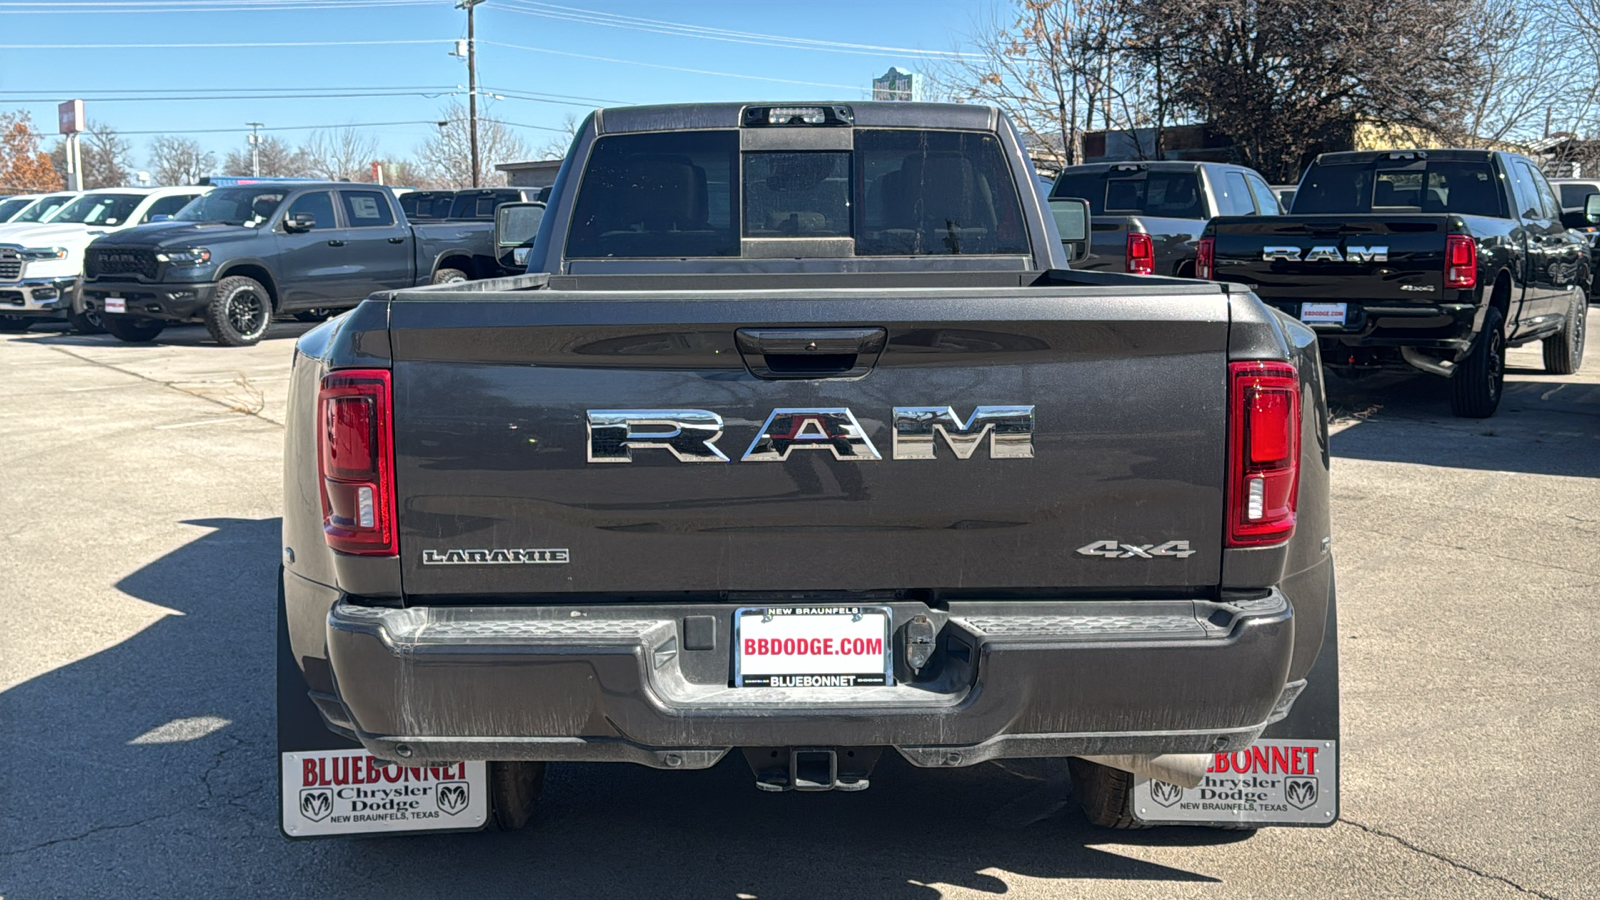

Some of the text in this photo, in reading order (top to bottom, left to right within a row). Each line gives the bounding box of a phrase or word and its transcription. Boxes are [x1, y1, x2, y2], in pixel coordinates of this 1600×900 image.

[1262, 246, 1389, 262] RAM
[587, 405, 1036, 463] RAM
[422, 548, 570, 565] LARAMIE
[1075, 540, 1197, 559] 4x4
[768, 607, 859, 615] NEW BRAUNFELS
[744, 637, 882, 656] BBDODGE.COM
[770, 676, 856, 687] BLUEBONNET
[1205, 745, 1319, 775] BONNET
[1198, 776, 1281, 791] hrysler
[336, 784, 433, 801] Chrysler
[1201, 788, 1268, 803] Dodge
[351, 798, 420, 813] Dodge
[1180, 802, 1288, 812] NEW BRAUNFELS, TEXAS
[330, 811, 440, 823] NEW BRAUNFELS, TEXAS
